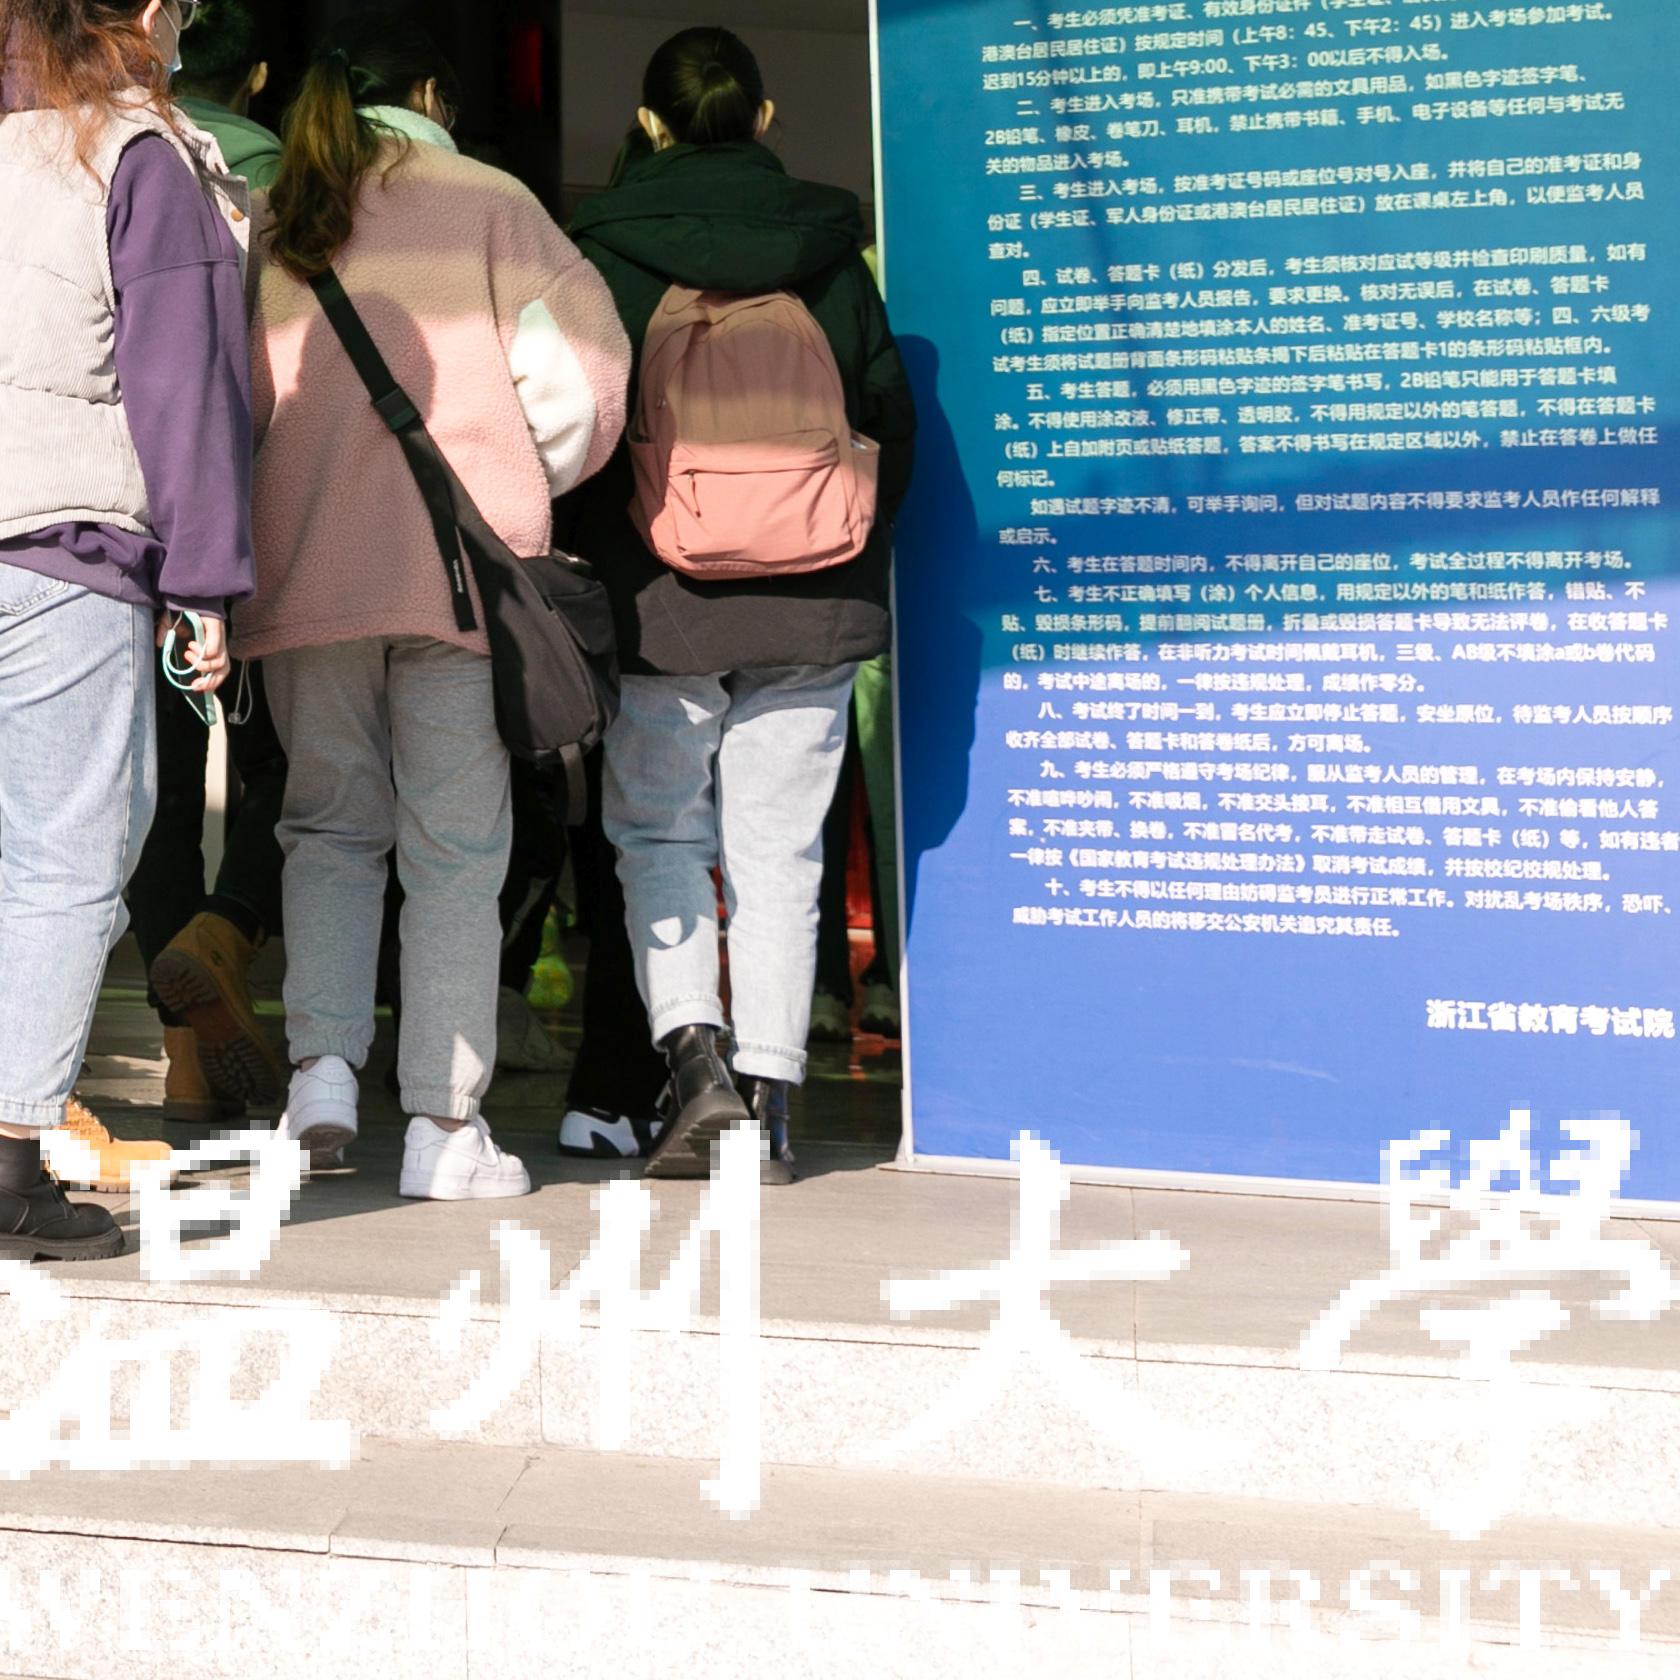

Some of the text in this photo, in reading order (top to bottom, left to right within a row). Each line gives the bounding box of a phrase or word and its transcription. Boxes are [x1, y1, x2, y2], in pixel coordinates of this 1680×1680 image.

[985, 151, 1130, 175] 关的物品进入考场。
[988, 241, 1031, 259] 查对。
[996, 471, 1056, 488] 何标记。
[998, 528, 1058, 545] 或启示。
[1425, 999, 1676, 1039] 浙江省教育考试院
